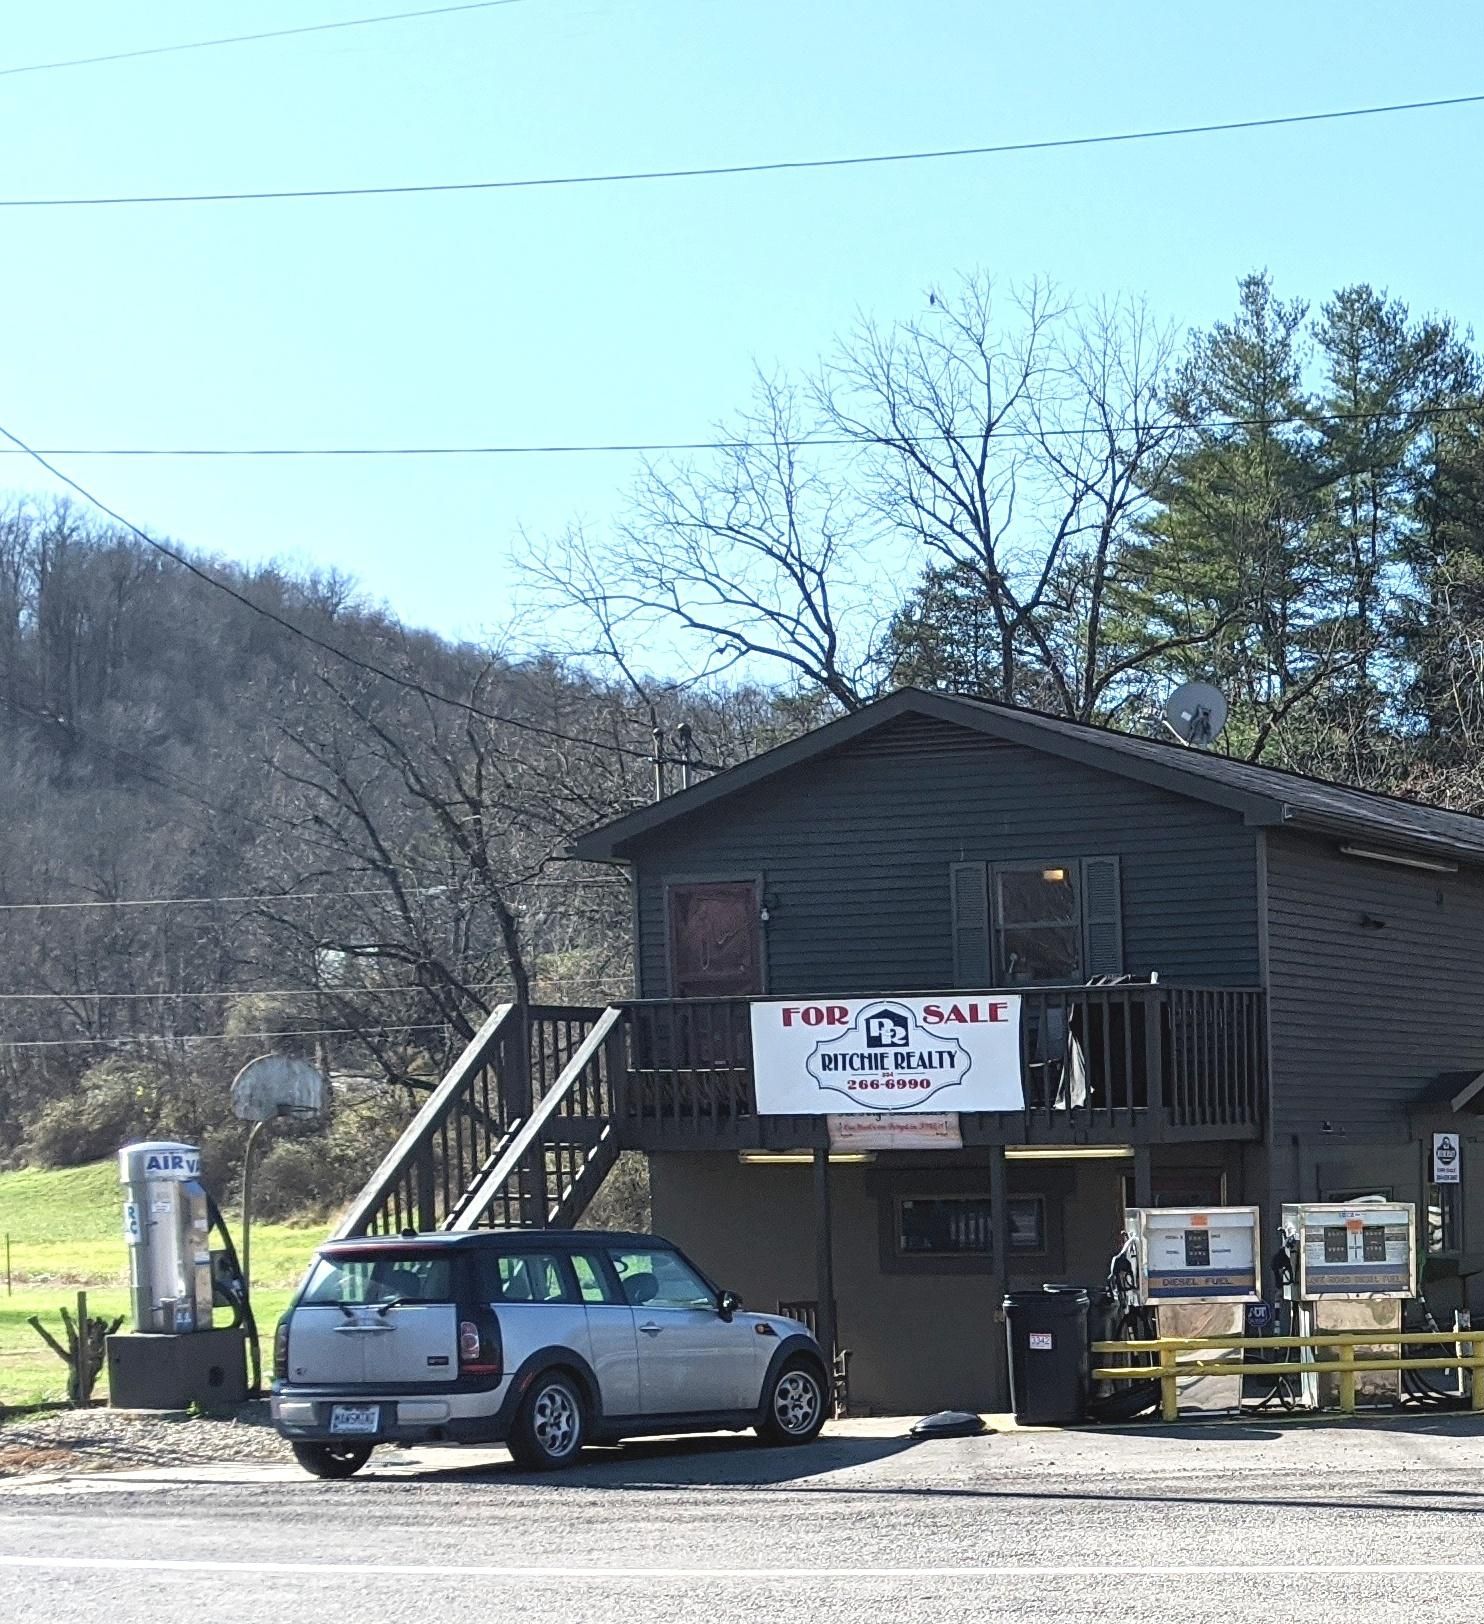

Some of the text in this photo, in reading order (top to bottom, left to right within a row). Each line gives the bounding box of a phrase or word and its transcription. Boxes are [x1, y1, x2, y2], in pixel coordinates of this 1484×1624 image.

[782, 1002, 1009, 1027] FOR SALE
[821, 1050, 957, 1072] RITCHIE REALTY
[847, 1078, 931, 1090] 266-6990
[146, 1155, 184, 1171] AIR
[1162, 1278, 1196, 1286] DIESEL
